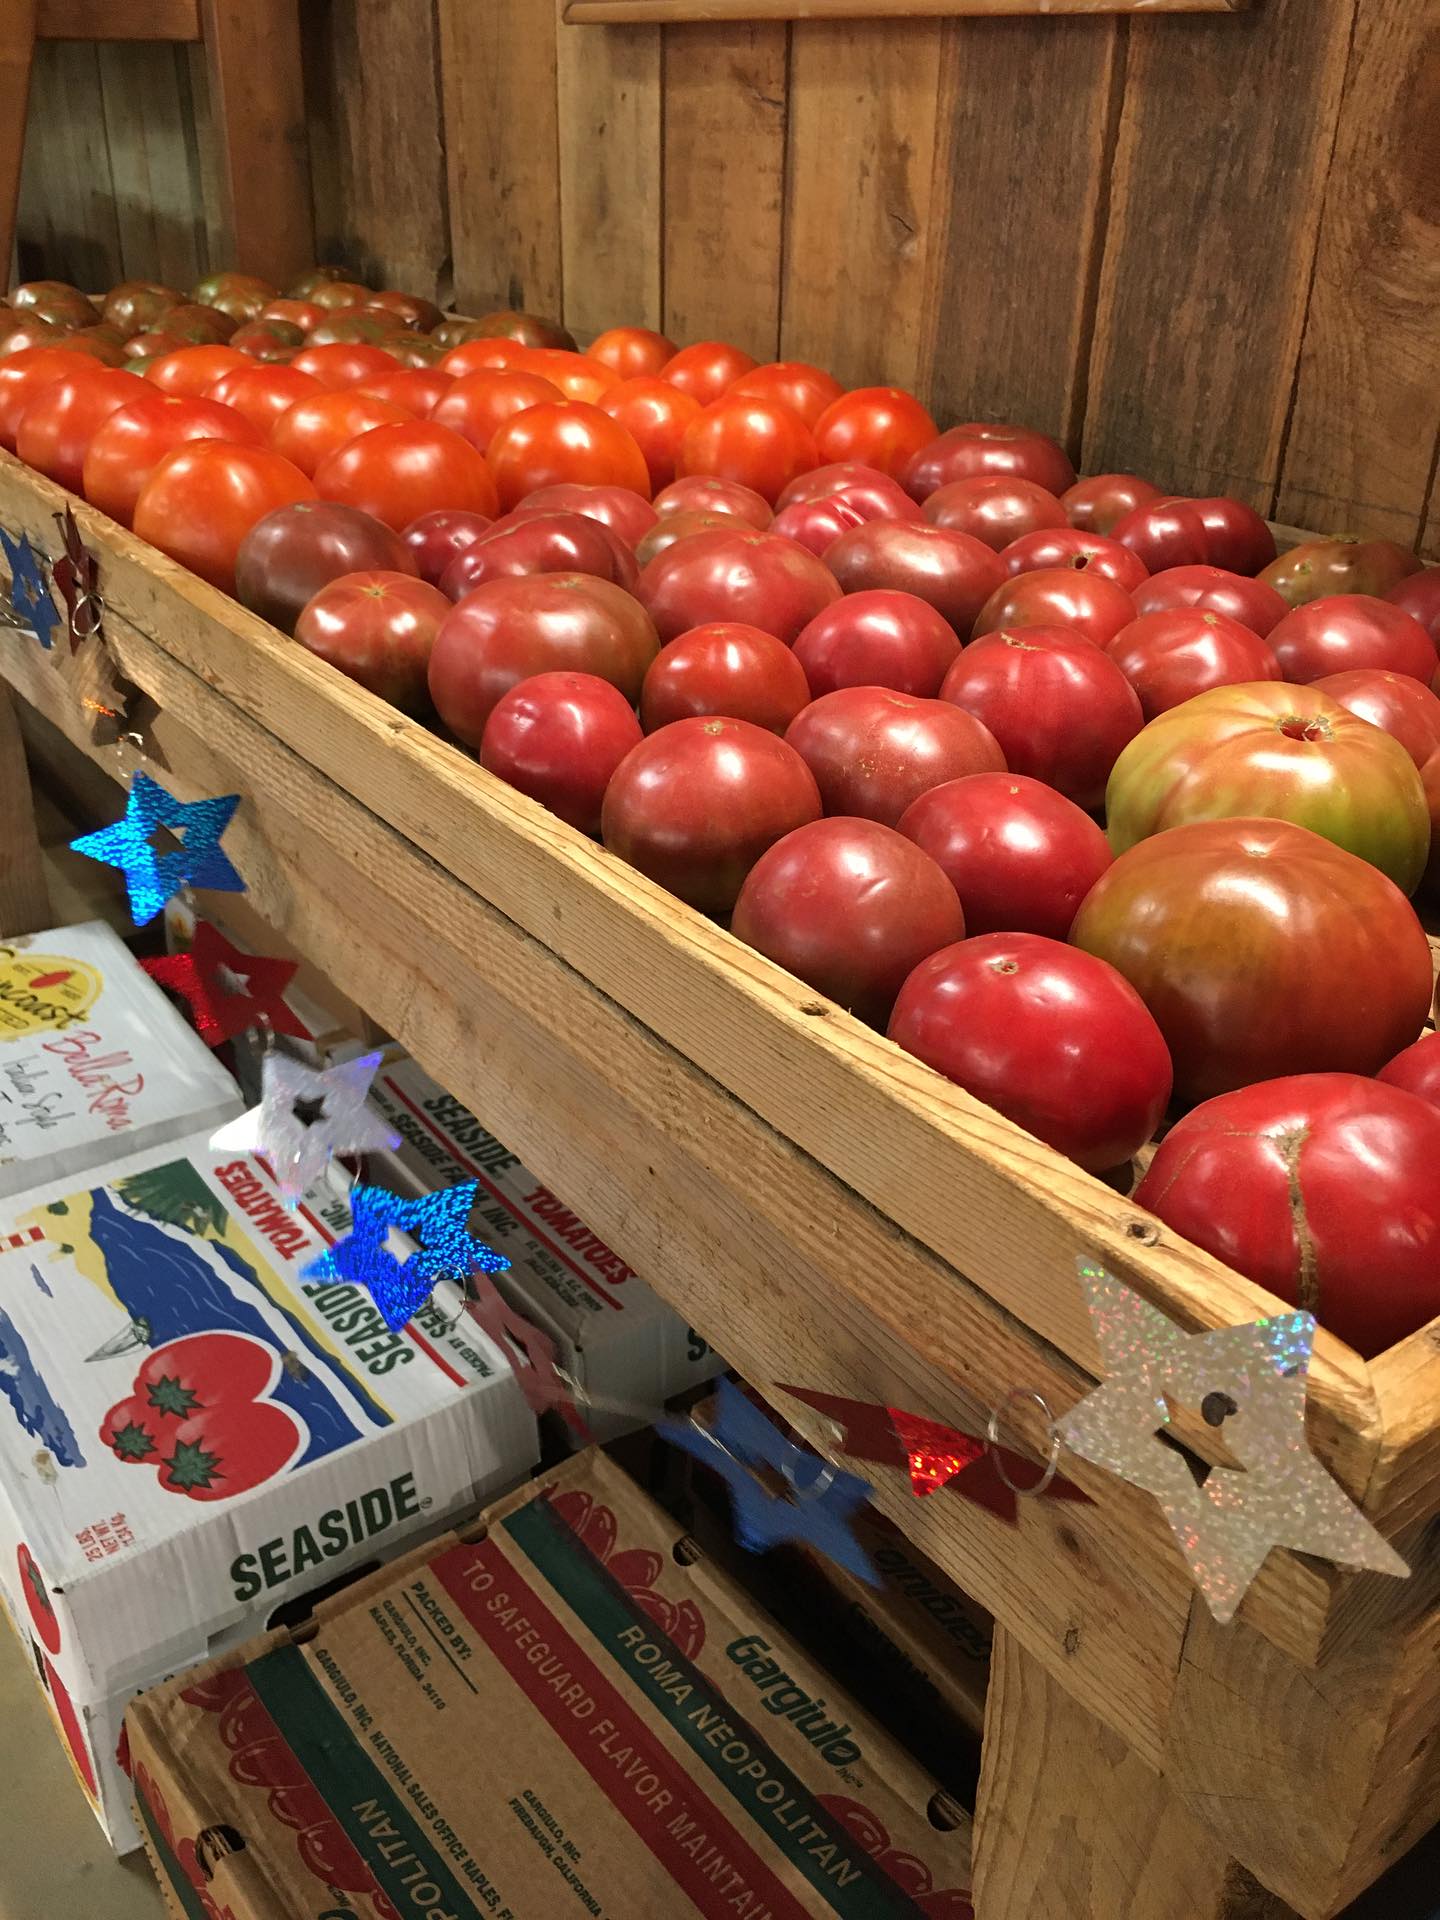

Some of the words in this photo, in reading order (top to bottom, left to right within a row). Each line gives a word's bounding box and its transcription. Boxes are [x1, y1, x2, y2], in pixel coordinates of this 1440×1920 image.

[388, 1111, 452, 1173] SEASIDE
[213, 1160, 311, 1261] TOMATOES
[523, 1184, 639, 1286] TOMATOES
[459, 1348, 496, 1378] PACKED
[230, 1472, 422, 1602] SEASIDE
[368, 1606, 396, 1647] NAPLES,
[394, 1641, 425, 1683] FLORIDA
[421, 1681, 446, 1711] 34110
[382, 1600, 417, 1649] GARGIULO,
[413, 1646, 432, 1668] INC.
[411, 1581, 455, 1641] PACKED
[450, 1635, 473, 1662] BY:
[462, 1559, 495, 1593] TO
[486, 1592, 596, 1720] SAFEGUARD
[588, 1717, 674, 1815] FLAVOR
[666, 1811, 773, 1920] MAINTAI
[725, 1635, 862, 1767] Gargiulo
[314, 1648, 355, 1709] GARGIULO,
[351, 1703, 373, 1733] INC.
[369, 1730, 412, 1786] NATIONAL
[407, 1783, 439, 1820] SALES
[431, 1818, 469, 1862] OFFICE
[461, 1858, 502, 1913] NAPLES,
[616, 1624, 696, 1706] ROMA
[687, 1704, 862, 1888] NEOPOLITAN
[508, 1797, 553, 1860] FIREBAUGH,
[553, 1854, 602, 1917] CALIFORNIA
[522, 1789, 564, 1845] GARGIULO,
